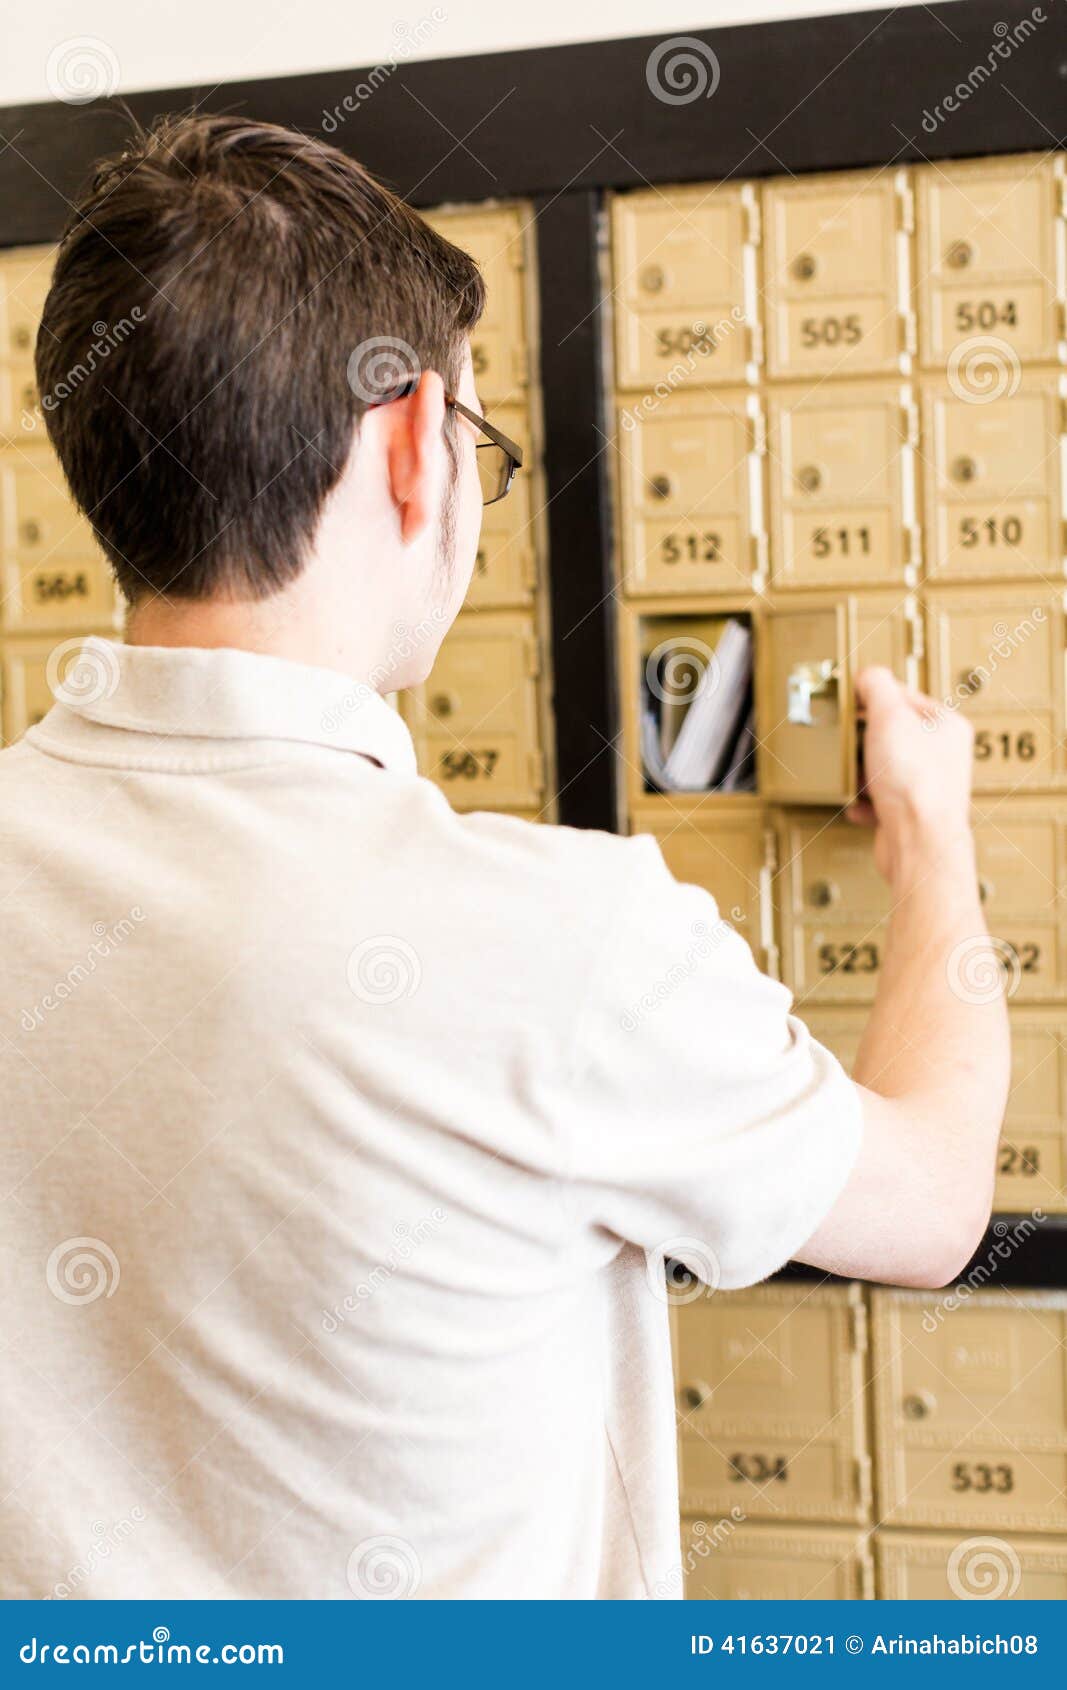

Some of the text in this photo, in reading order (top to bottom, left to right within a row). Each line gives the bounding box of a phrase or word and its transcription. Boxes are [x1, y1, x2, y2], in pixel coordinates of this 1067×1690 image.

[801, 315, 862, 348] 505
[956, 300, 1018, 332] 504
[812, 527, 872, 558] 511
[959, 515, 1023, 547] 510
[661, 533, 721, 565] 512
[974, 730, 1037, 761] 516
[440, 748, 498, 780] 567
[818, 943, 880, 974] 523
[1001, 942, 1041, 974] 22
[1000, 1146, 1040, 1175] 28
[729, 1452, 788, 1484] 534
[951, 1463, 1014, 1494] 533
